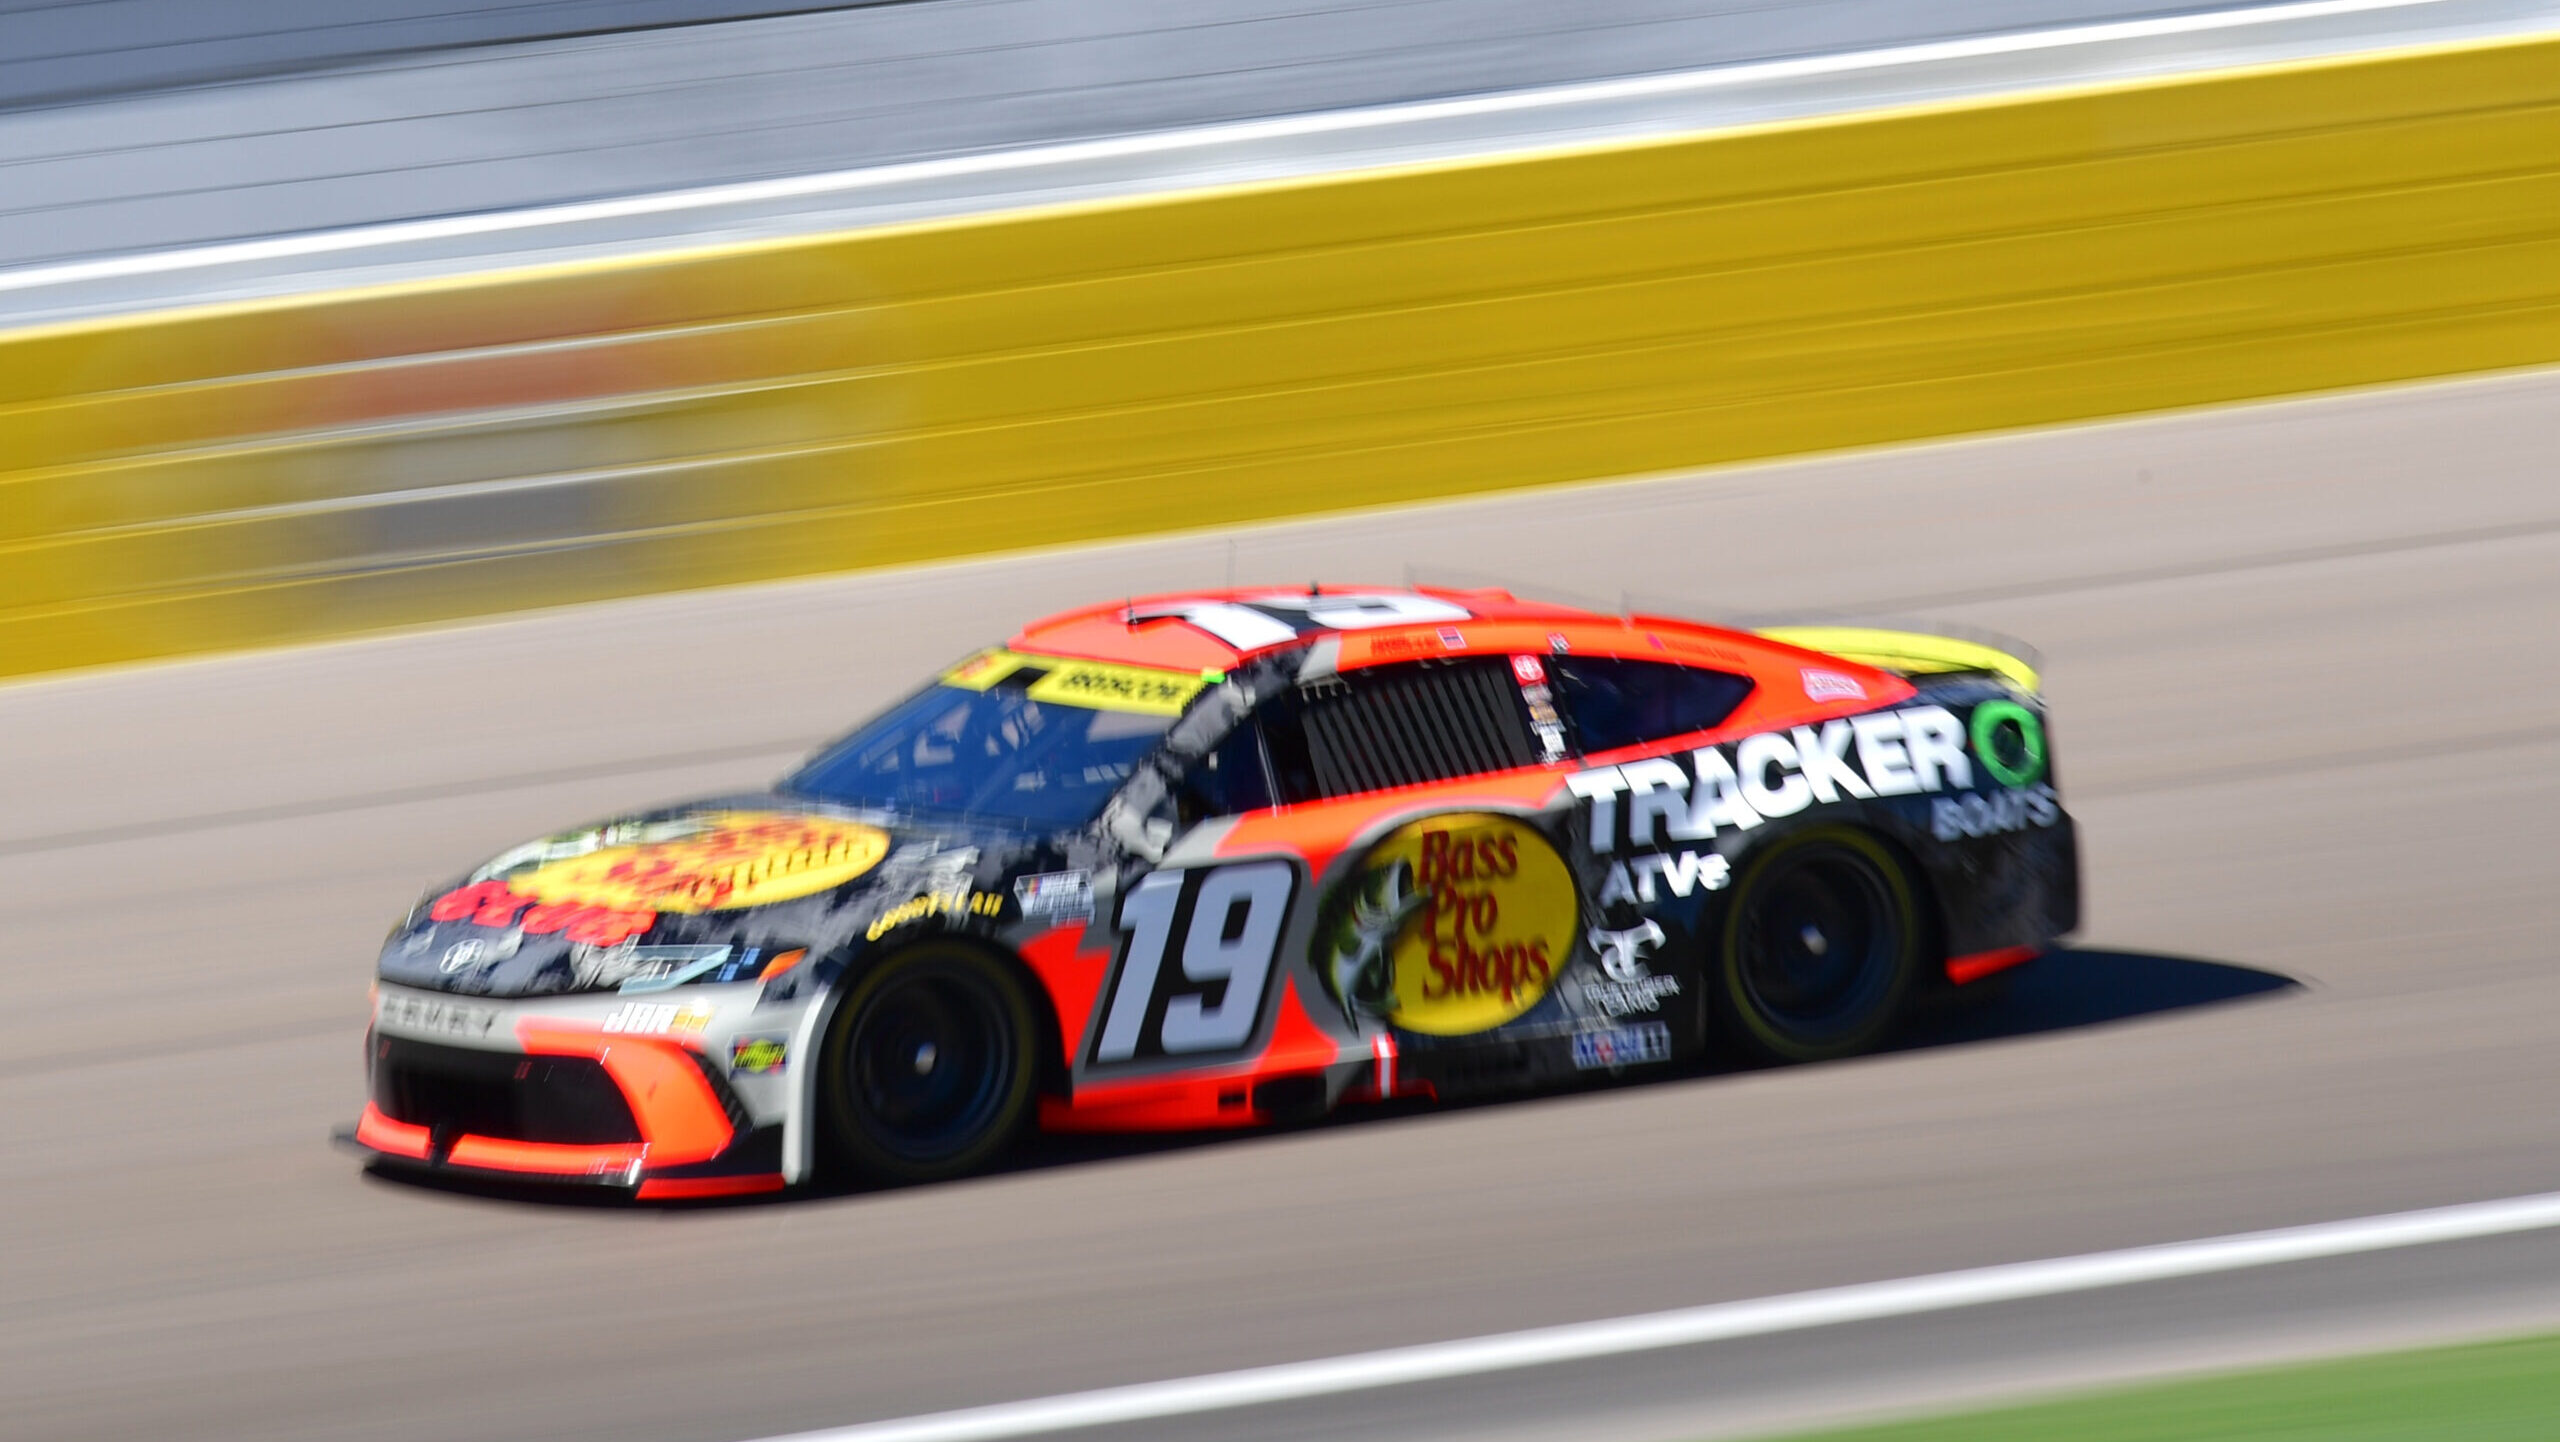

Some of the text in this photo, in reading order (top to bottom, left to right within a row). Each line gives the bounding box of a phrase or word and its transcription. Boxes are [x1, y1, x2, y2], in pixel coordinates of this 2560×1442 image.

[1563, 705, 1975, 854] TRACKER
[1931, 780, 2060, 842] BOATS
[1417, 828, 1519, 886] Bass
[1418, 884, 1499, 942] Pro
[1097, 860, 1294, 1063] 19
[1421, 936, 1551, 1002] Shops
